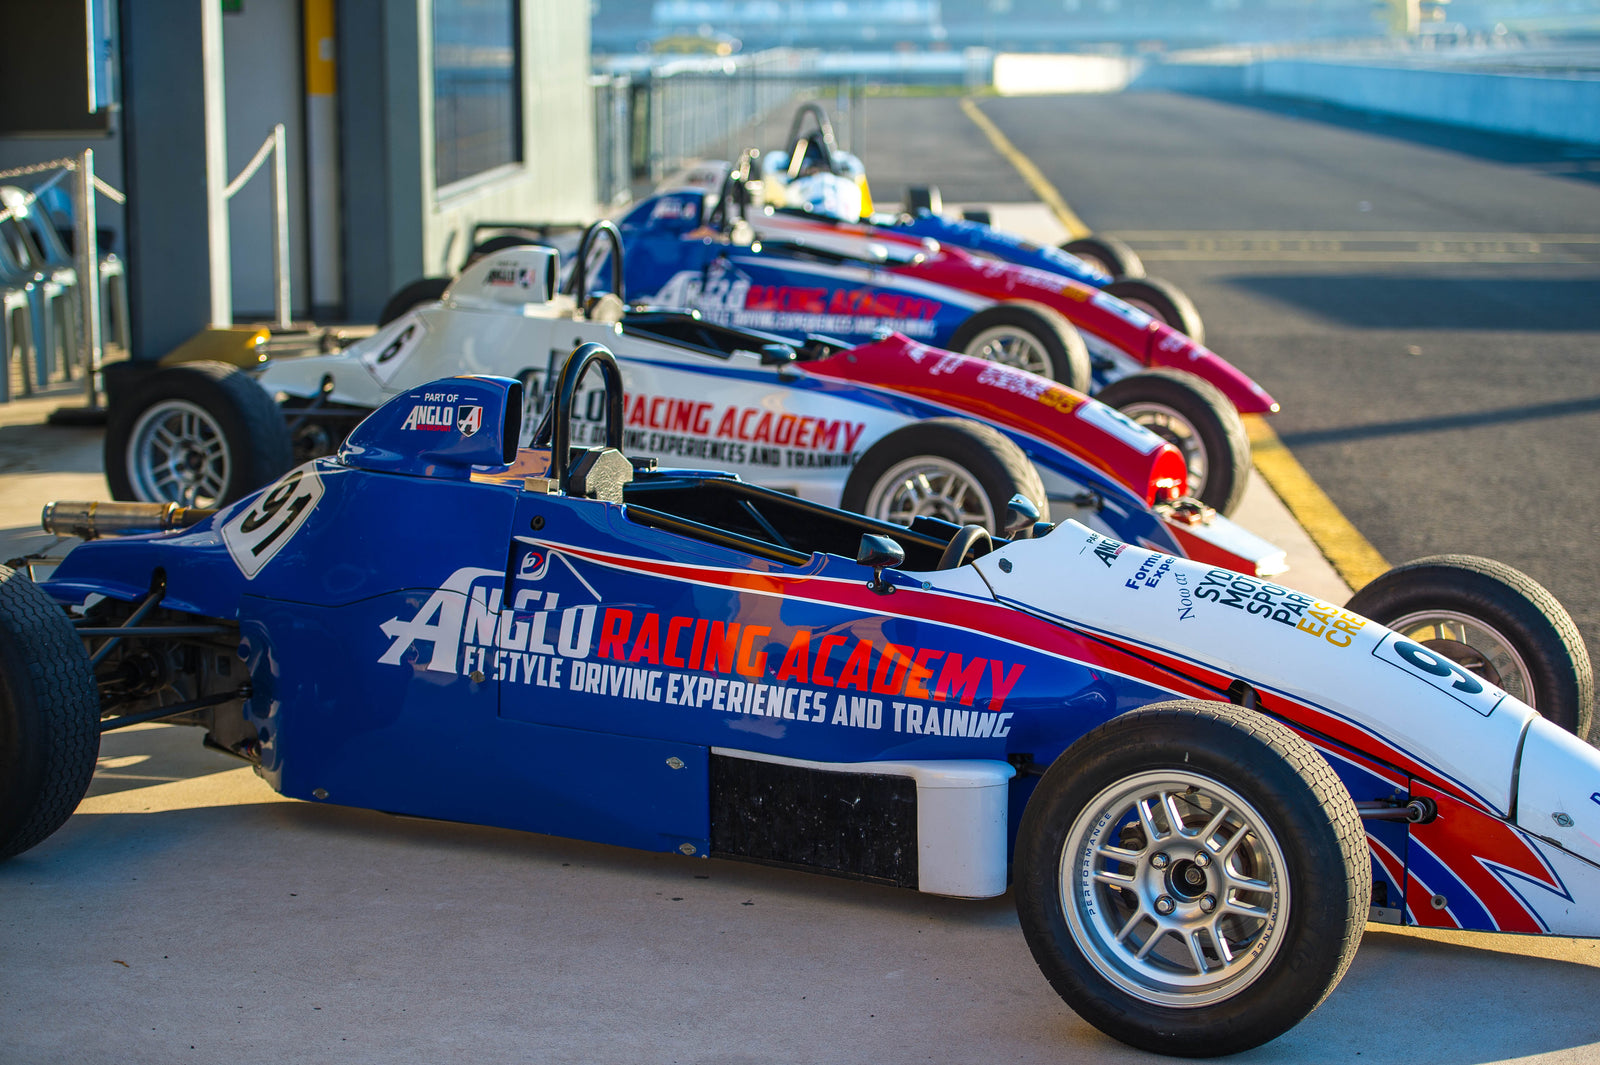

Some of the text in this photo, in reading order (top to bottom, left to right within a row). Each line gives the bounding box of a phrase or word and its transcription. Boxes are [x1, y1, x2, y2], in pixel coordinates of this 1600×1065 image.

[400, 405, 454, 431] ANGLO
[424, 393, 459, 403] PART OF
[622, 391, 714, 436] ACING
[716, 406, 866, 454] ACADEMY
[1194, 567, 1238, 603] SYD
[1246, 582, 1290, 619] SPO
[377, 566, 1026, 712] ANGLO RACING ACADEMY
[463, 645, 1015, 738] F1 STYLE DRIVING EXPERIENCES AND TRAINING
[1082, 812, 1112, 916] PERFORMANCE
